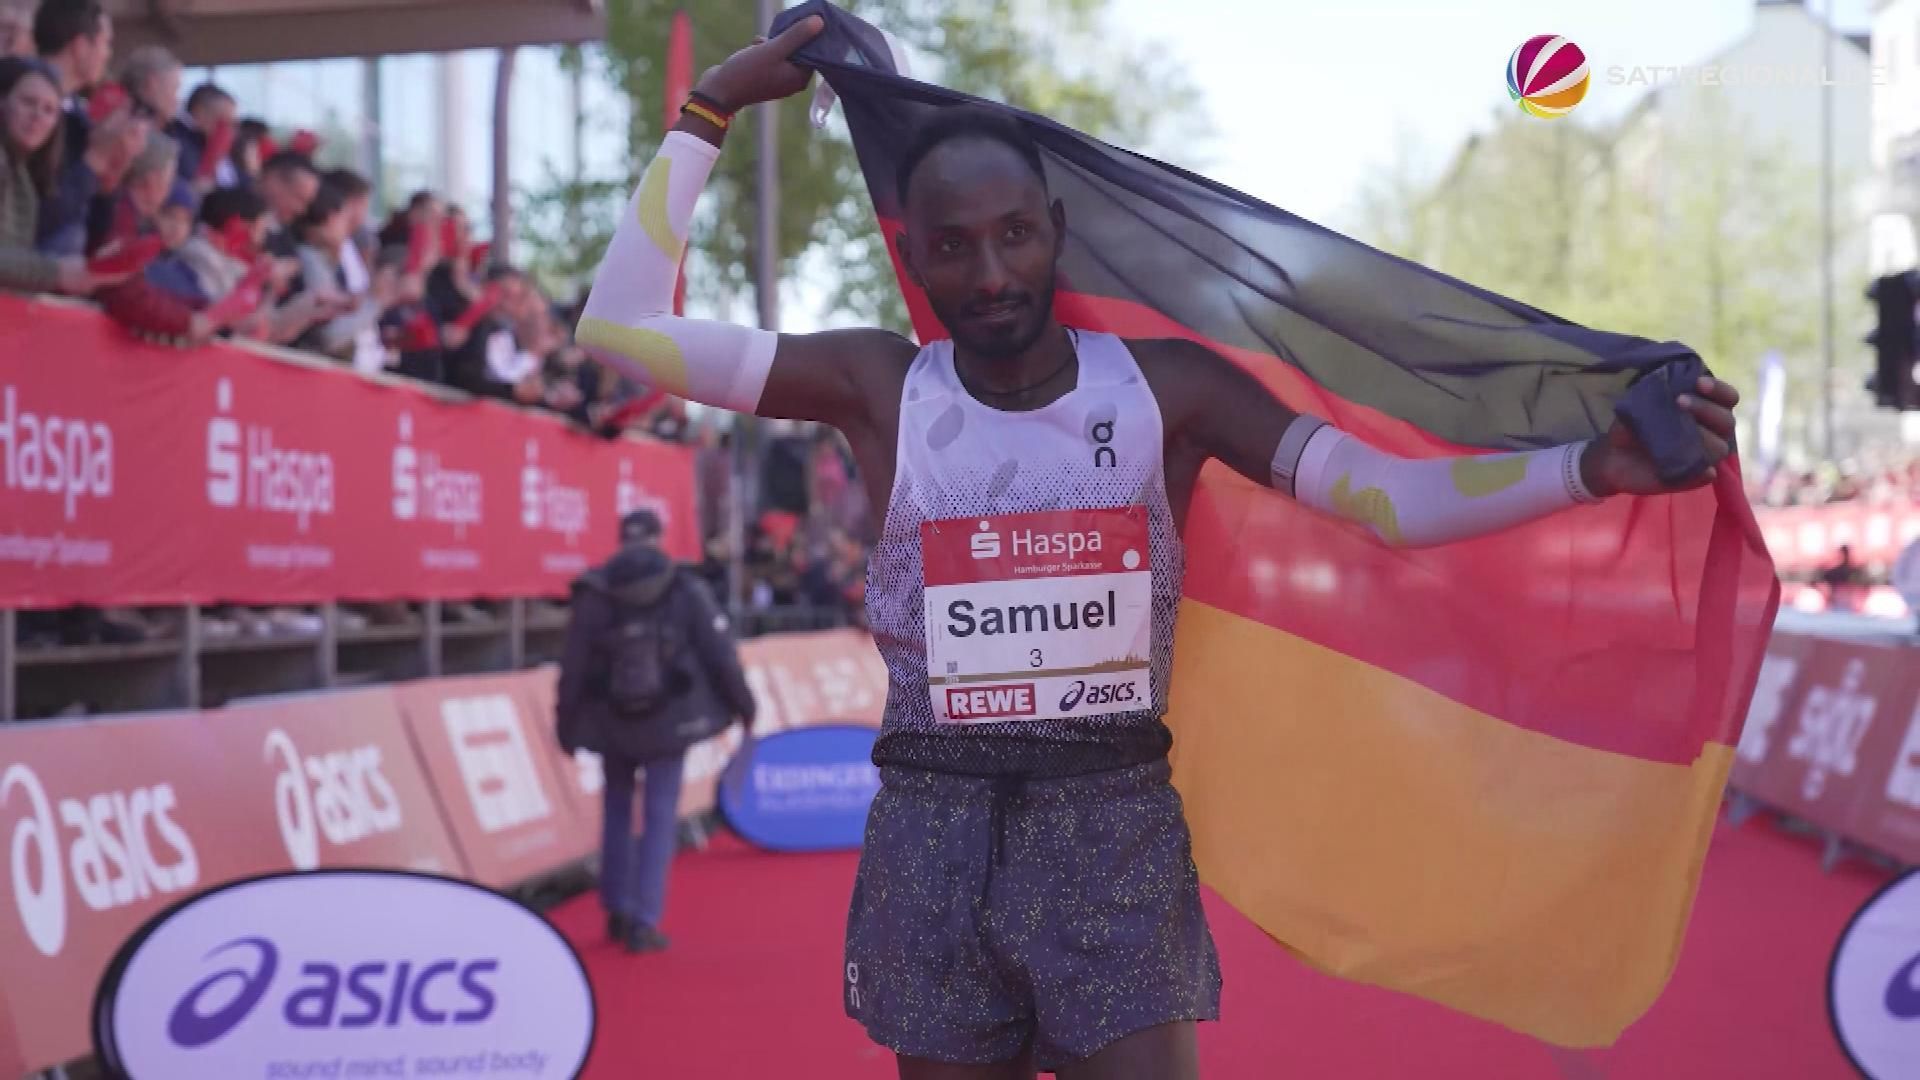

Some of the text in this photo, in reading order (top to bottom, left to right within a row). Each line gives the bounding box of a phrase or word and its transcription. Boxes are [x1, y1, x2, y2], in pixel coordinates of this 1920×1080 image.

[247, 423, 334, 533] Haspa
[1012, 529, 1102, 560] Haspa
[1014, 564, 1060, 574] Hamburger
[947, 590, 1116, 637] Samuel
[1029, 648, 1043, 667] 3
[950, 688, 1033, 715] REWE
